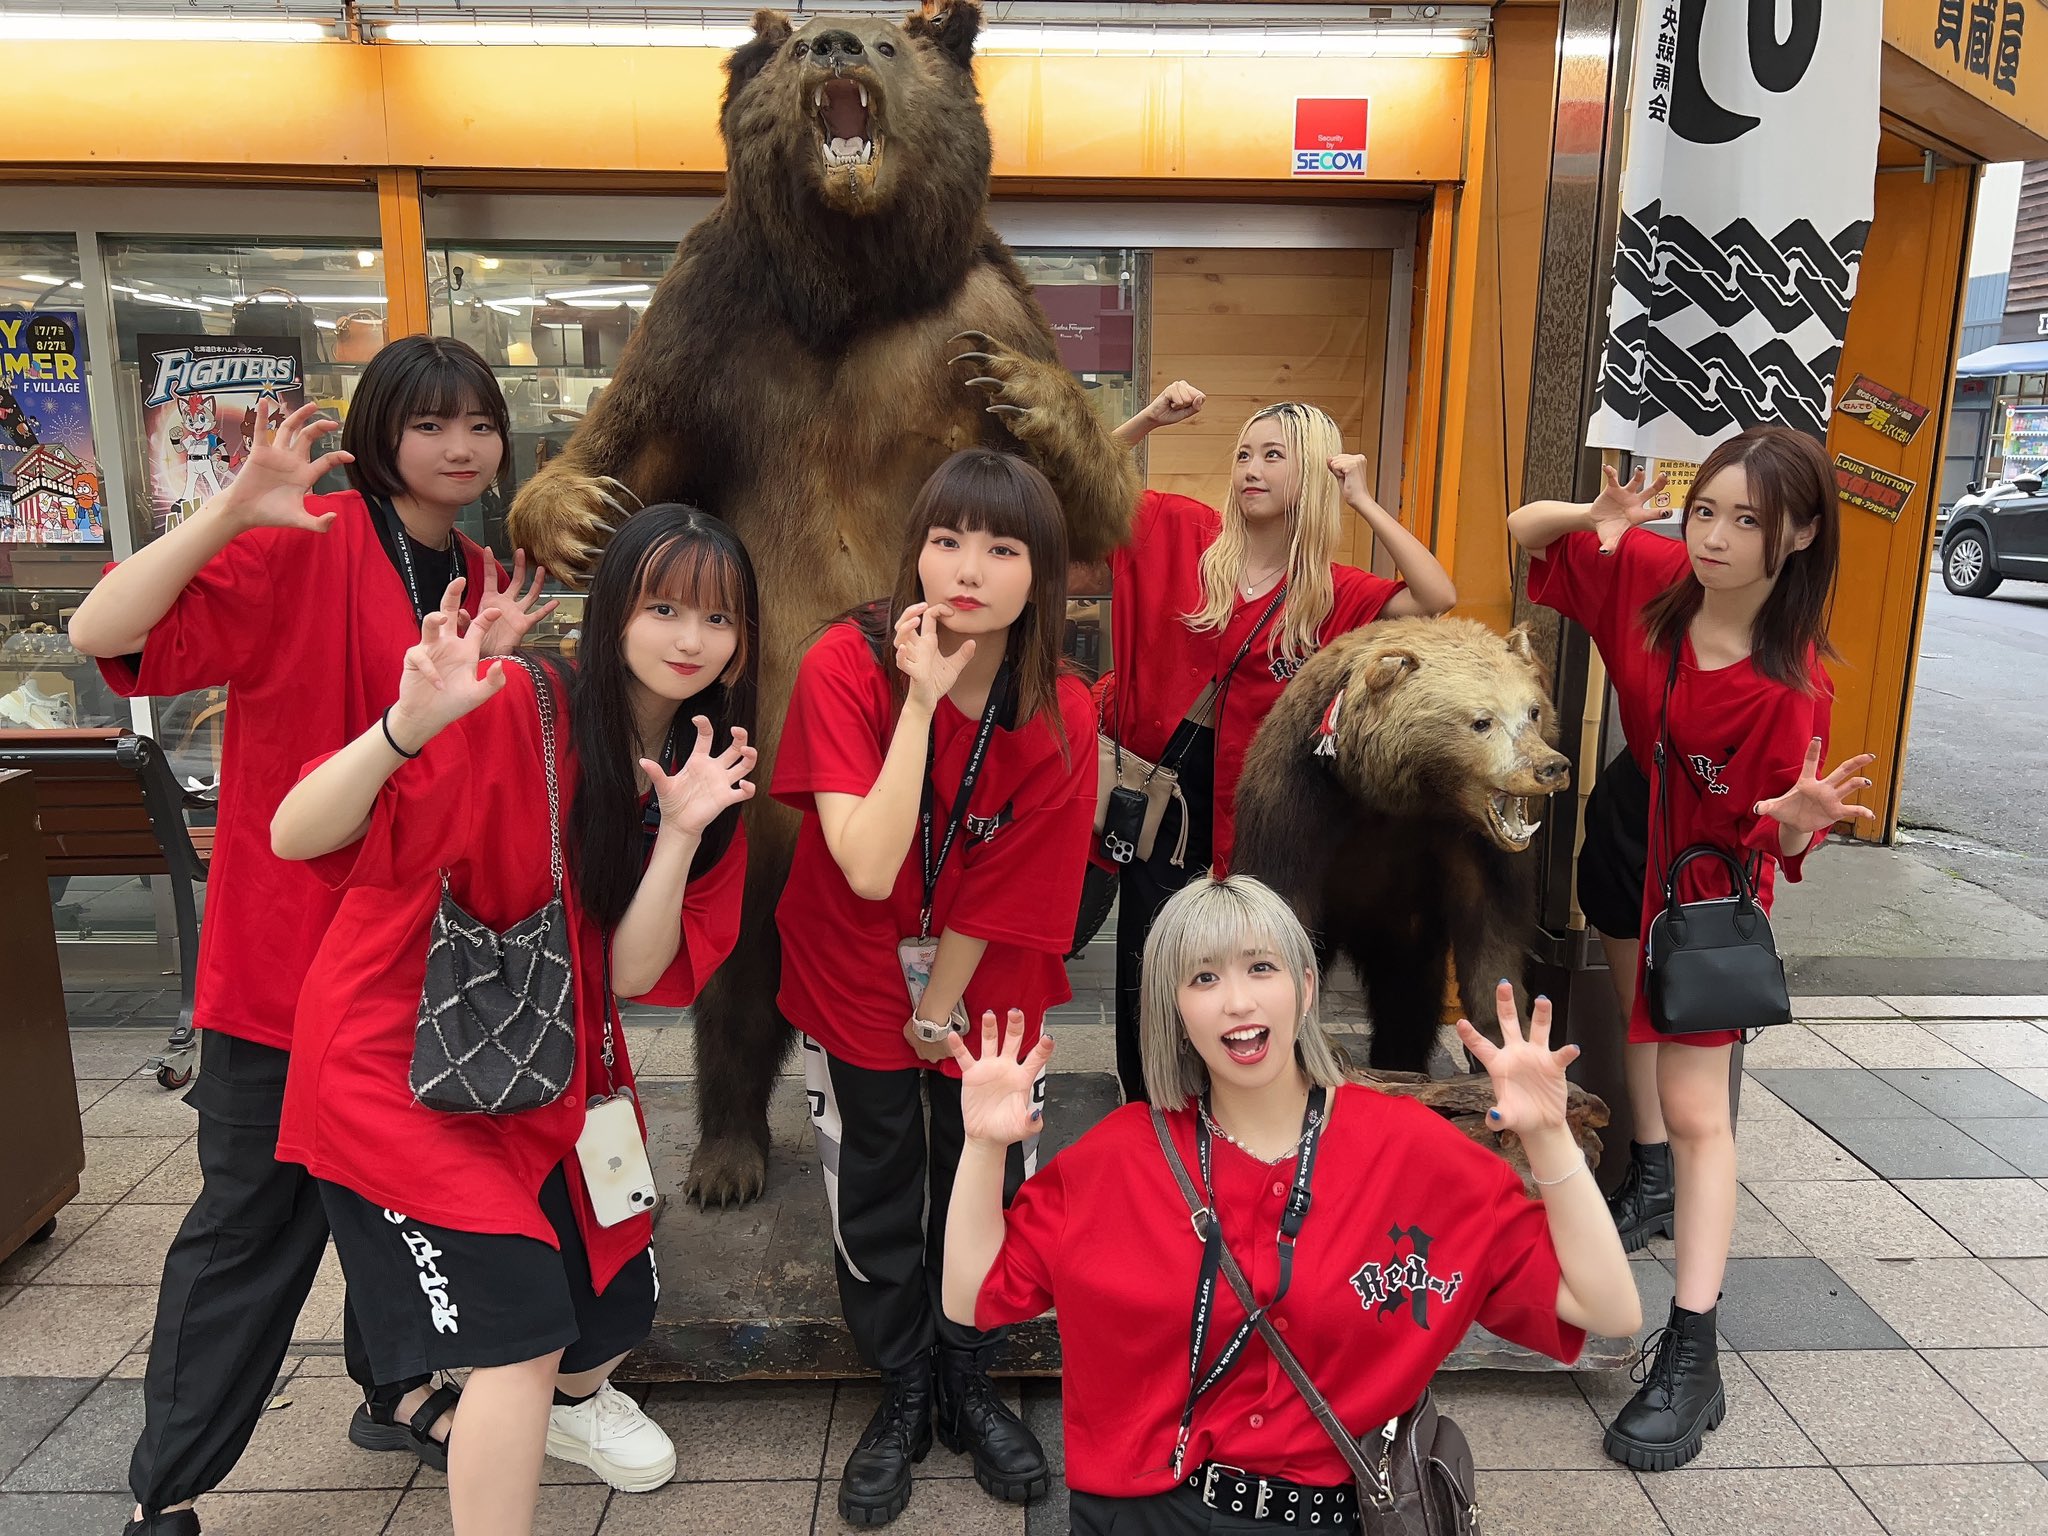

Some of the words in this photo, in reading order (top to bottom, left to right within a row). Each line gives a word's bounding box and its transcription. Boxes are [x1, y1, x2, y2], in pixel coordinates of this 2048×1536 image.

[1317, 134, 1344, 143] Security
[1297, 152, 1362, 170] SECOM
[0, 319, 23, 349] Y
[0, 352, 79, 380] MER
[23, 382, 30, 393] F
[33, 382, 80, 393] VILLAGE
[1842, 402, 1873, 411] なんでも
[1836, 457, 1865, 475] LOUIS
[1870, 470, 1912, 494] VUITTON
[985, 704, 996, 724] Life
[981, 723, 990, 738] No
[973, 736, 986, 761] Rock
[969, 760, 978, 773] No
[1305, 1129, 1314, 1145] No
[1300, 1146, 1311, 1176] Rock
[1200, 1278, 1211, 1305] Life
[1197, 1305, 1206, 1323] No
[1193, 1324, 1203, 1356] Rock
[1238, 1324, 1249, 1338] No
[1220, 1338, 1241, 1366] Rock
[1211, 1365, 1223, 1379] No
